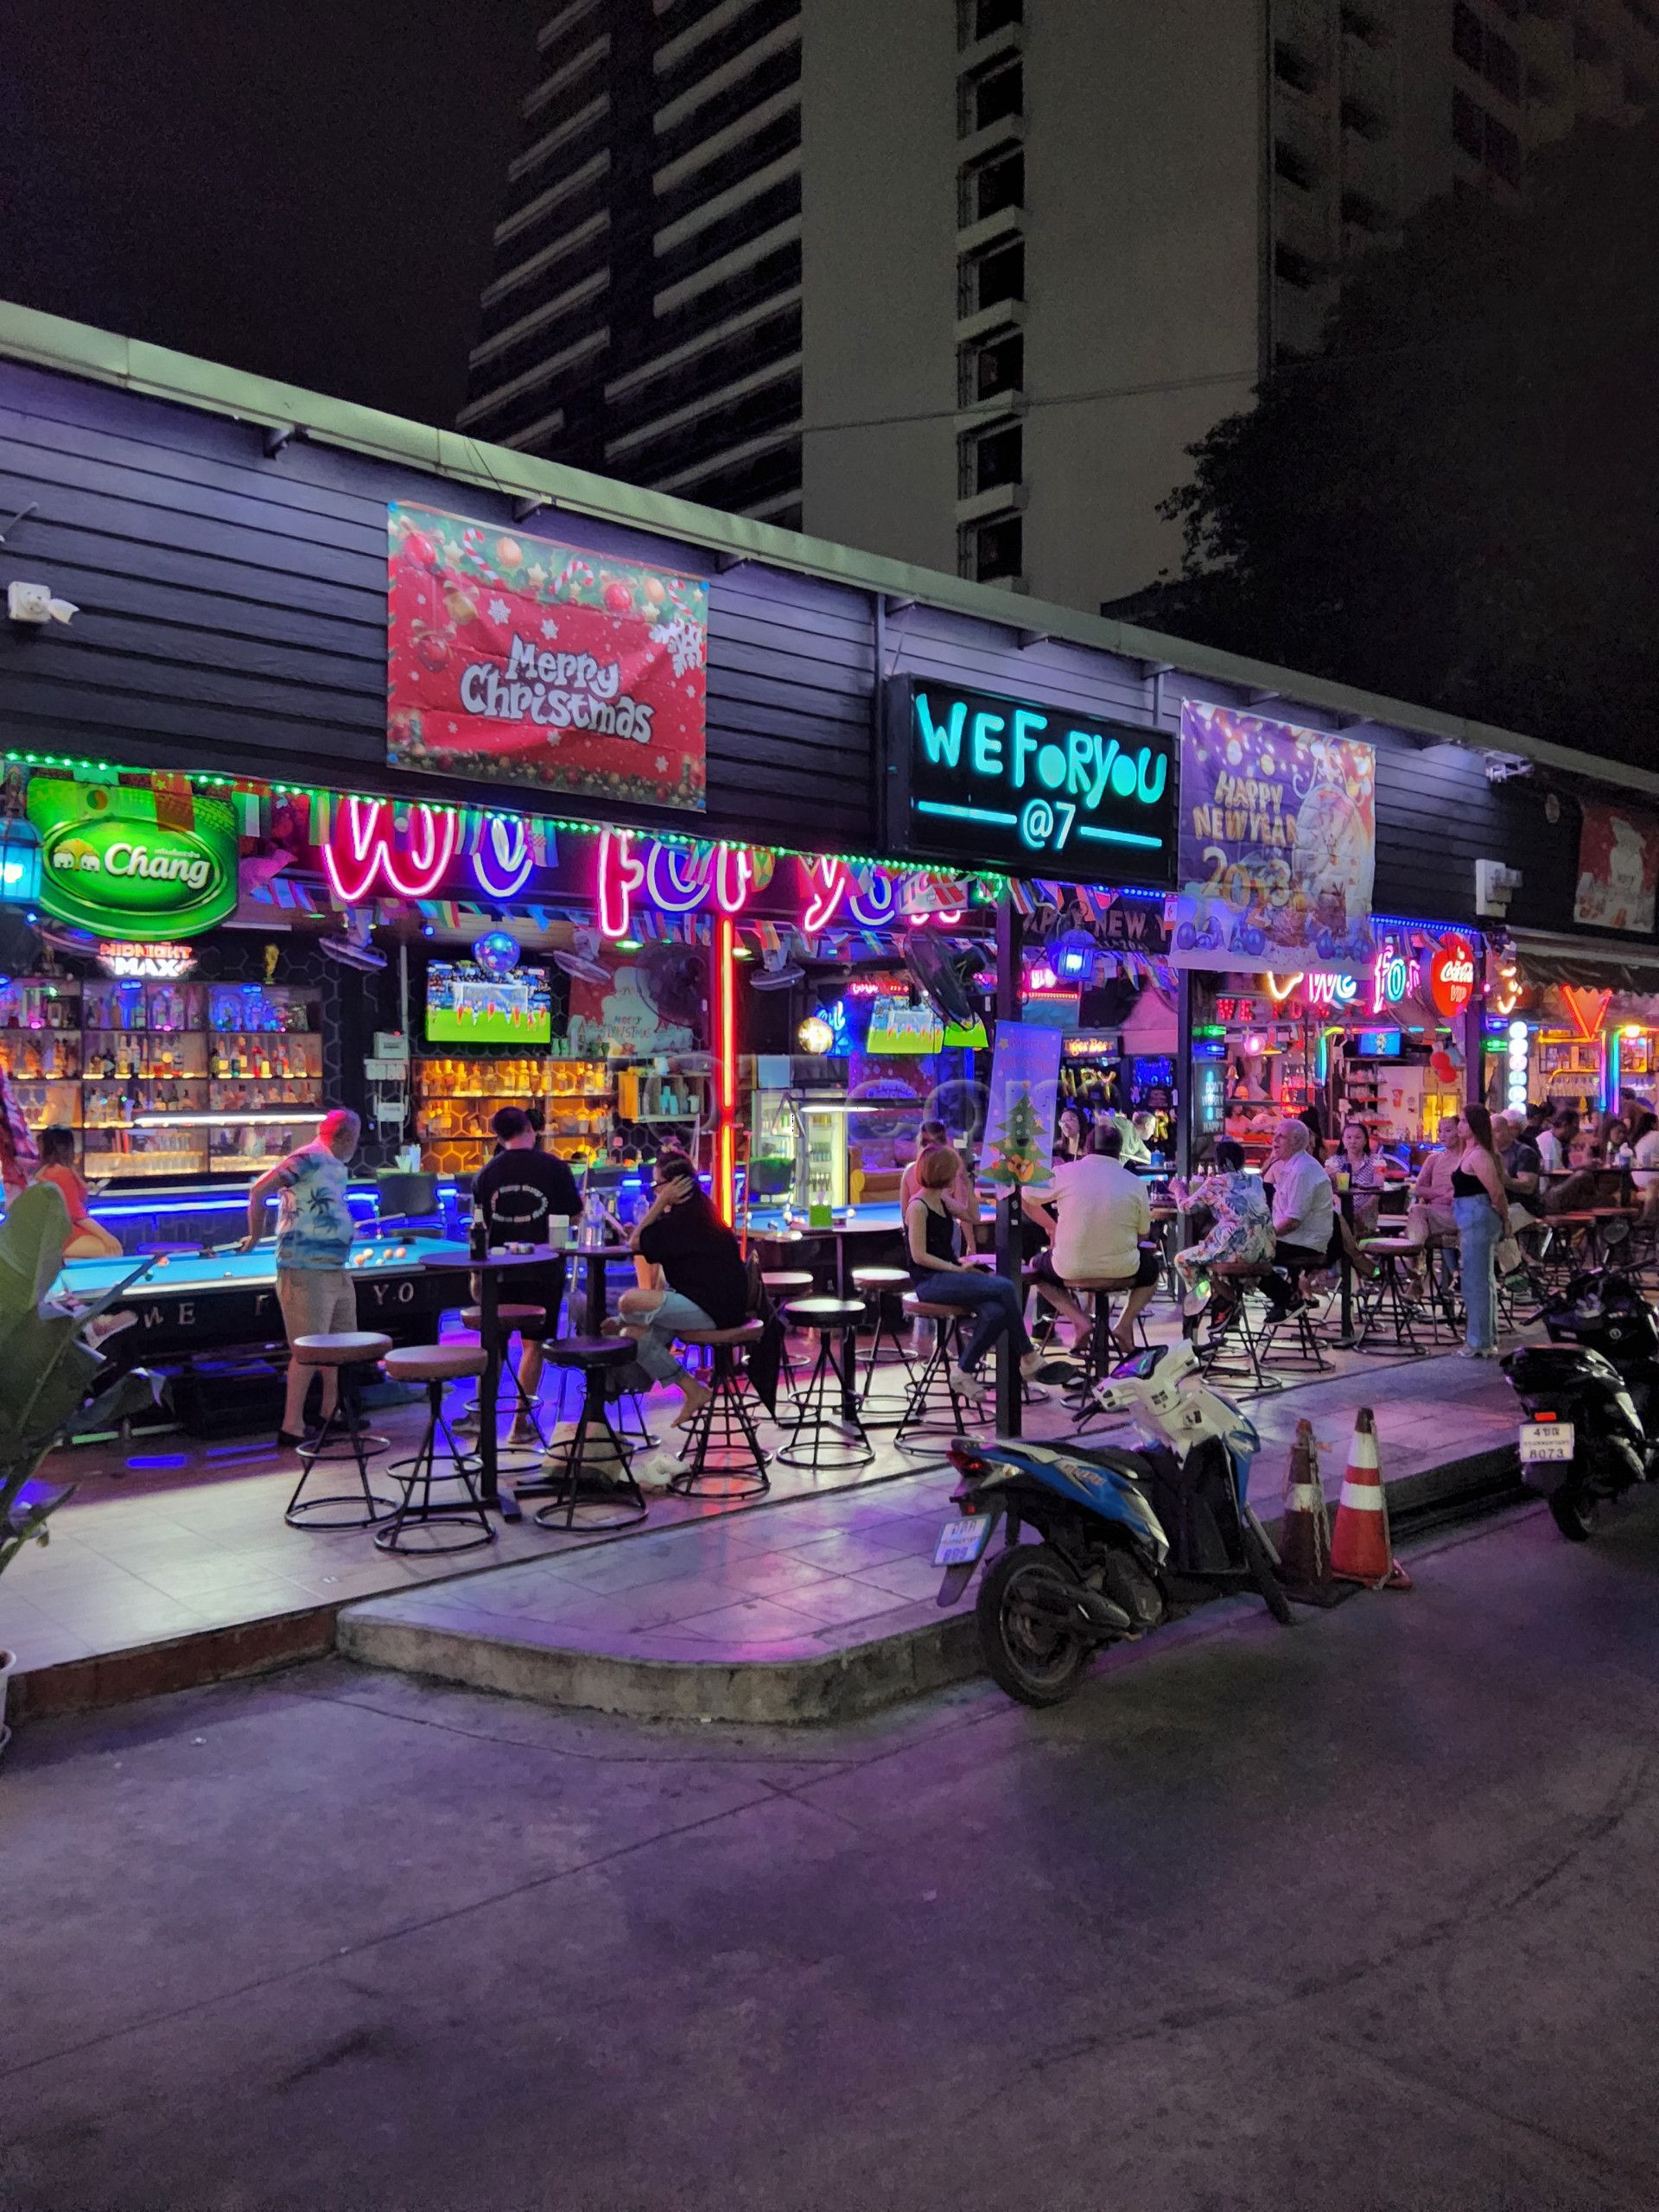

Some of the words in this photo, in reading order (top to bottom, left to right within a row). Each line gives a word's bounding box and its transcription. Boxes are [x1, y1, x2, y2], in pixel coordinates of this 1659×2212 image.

[507, 633, 620, 698] Merry
[460, 661, 655, 745] Christmas
[1214, 769, 1284, 815] HAPPY
[1022, 798, 1077, 850] @7
[104, 842, 211, 890] Chang
[99, 942, 193, 959] MIDNIGHT
[114, 957, 182, 977] MAX
[1450, 984, 1467, 1003] VIP
[1064, 1038, 1088, 1056] Tiger
[1089, 1038, 1115, 1052] Beer
